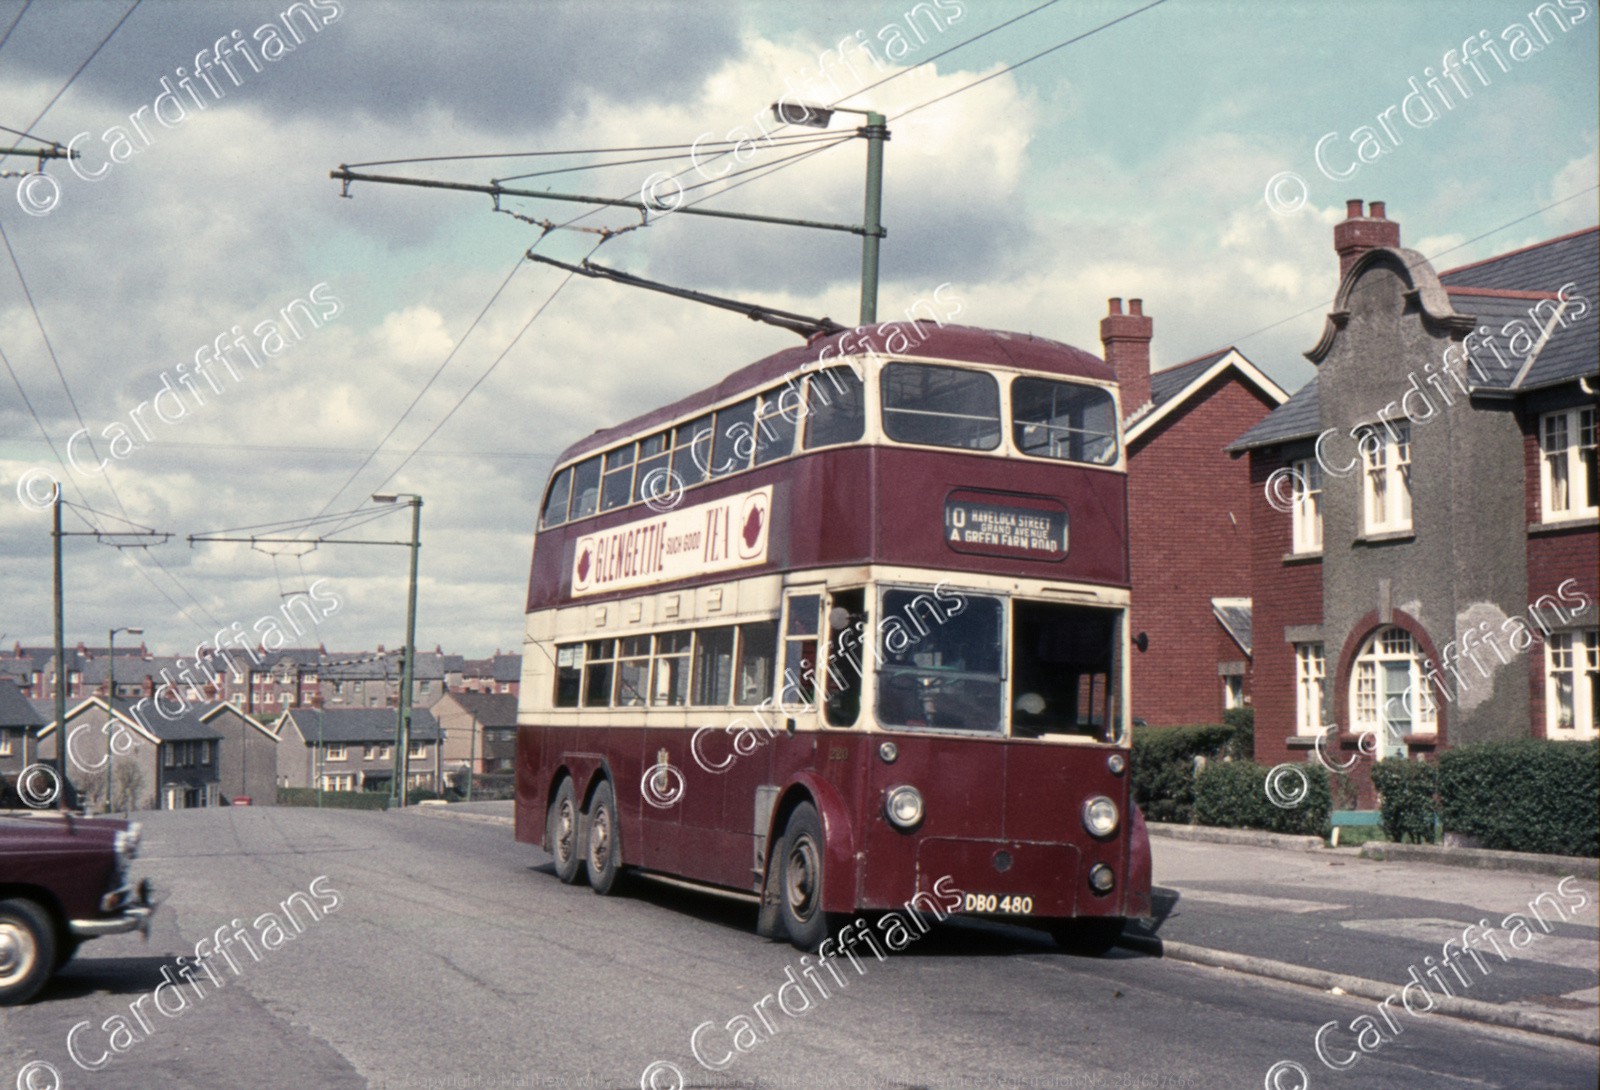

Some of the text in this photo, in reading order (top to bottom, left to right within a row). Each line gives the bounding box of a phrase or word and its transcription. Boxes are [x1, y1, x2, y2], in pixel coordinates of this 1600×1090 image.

[971, 510, 1051, 530] HAVELOCK STREET
[950, 529, 961, 542] A
[964, 530, 1058, 552] GREEN FARM ROAD
[981, 523, 1049, 540] GRAND AVENUE
[595, 521, 667, 584] GLENGETTIE
[683, 531, 701, 552] GOOD
[965, 894, 1033, 914] DBO 480
